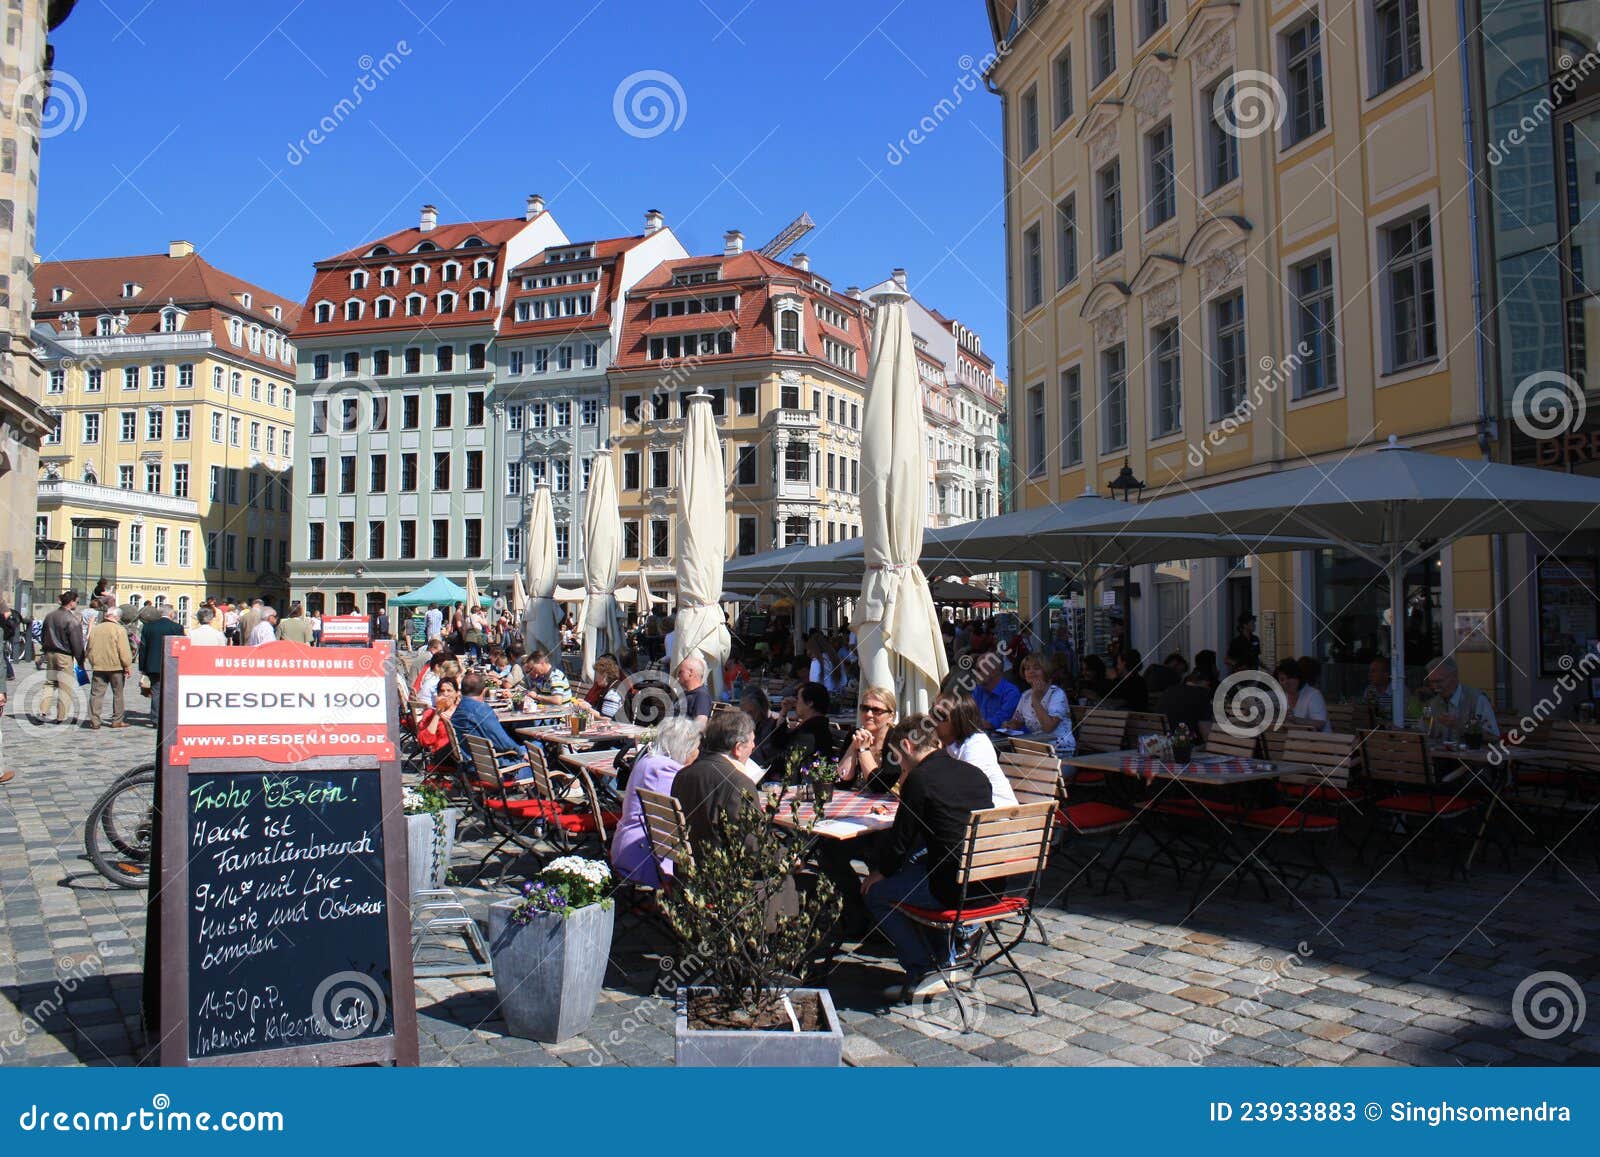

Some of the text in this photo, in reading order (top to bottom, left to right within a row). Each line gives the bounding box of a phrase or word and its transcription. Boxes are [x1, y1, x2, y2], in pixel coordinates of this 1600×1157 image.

[215, 658, 354, 669] MUSEUMSGASTRONOMIE
[185, 692, 380, 708] DRESDEN 1900
[264, 815, 295, 838] ist
[256, 869, 296, 901] mit
[199, 907, 258, 944] Musik
[267, 901, 309, 927] und
[201, 934, 279, 970] bemalen
